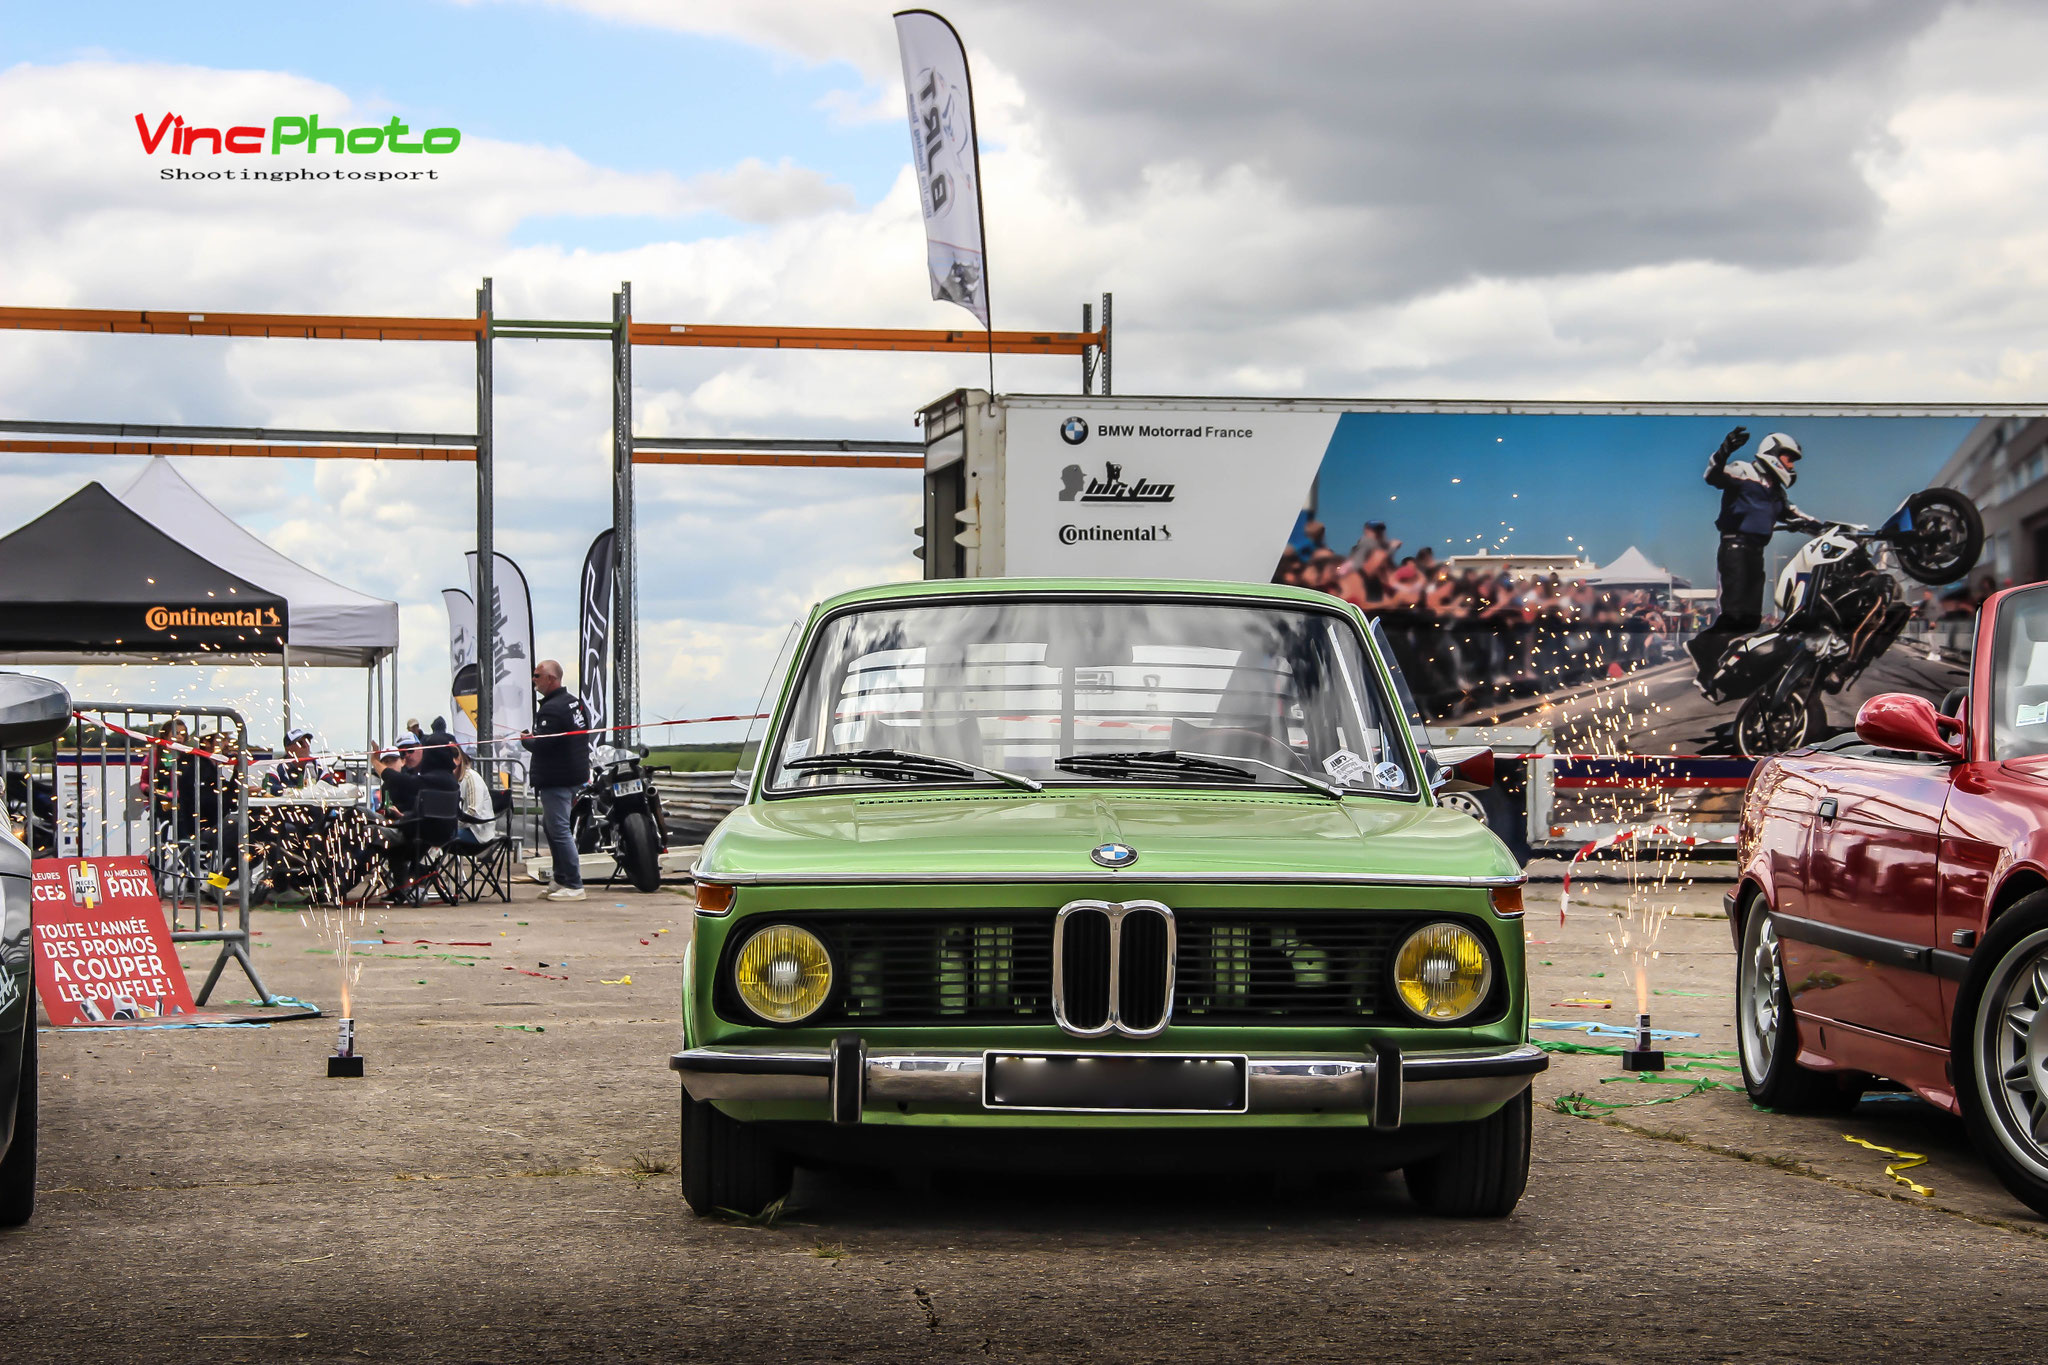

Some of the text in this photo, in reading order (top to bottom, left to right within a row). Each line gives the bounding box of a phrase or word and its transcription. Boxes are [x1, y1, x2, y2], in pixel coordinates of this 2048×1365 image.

[1098, 425, 1254, 438] BMW Motorrad France
[1058, 524, 1156, 545] Continental
[145, 606, 262, 631] Continental
[104, 870, 114, 878] AU
[114, 869, 148, 877] MEILLEUR
[32, 878, 154, 901] CES PRIX
[76, 886, 97, 894] AUTO
[36, 916, 149, 939] TOUTE L'ANNÉE
[43, 936, 157, 959] DES PROMOS
[54, 955, 166, 982] A COUPER
[58, 984, 86, 1003] LE
[84, 978, 167, 1001] SOUFFLE
